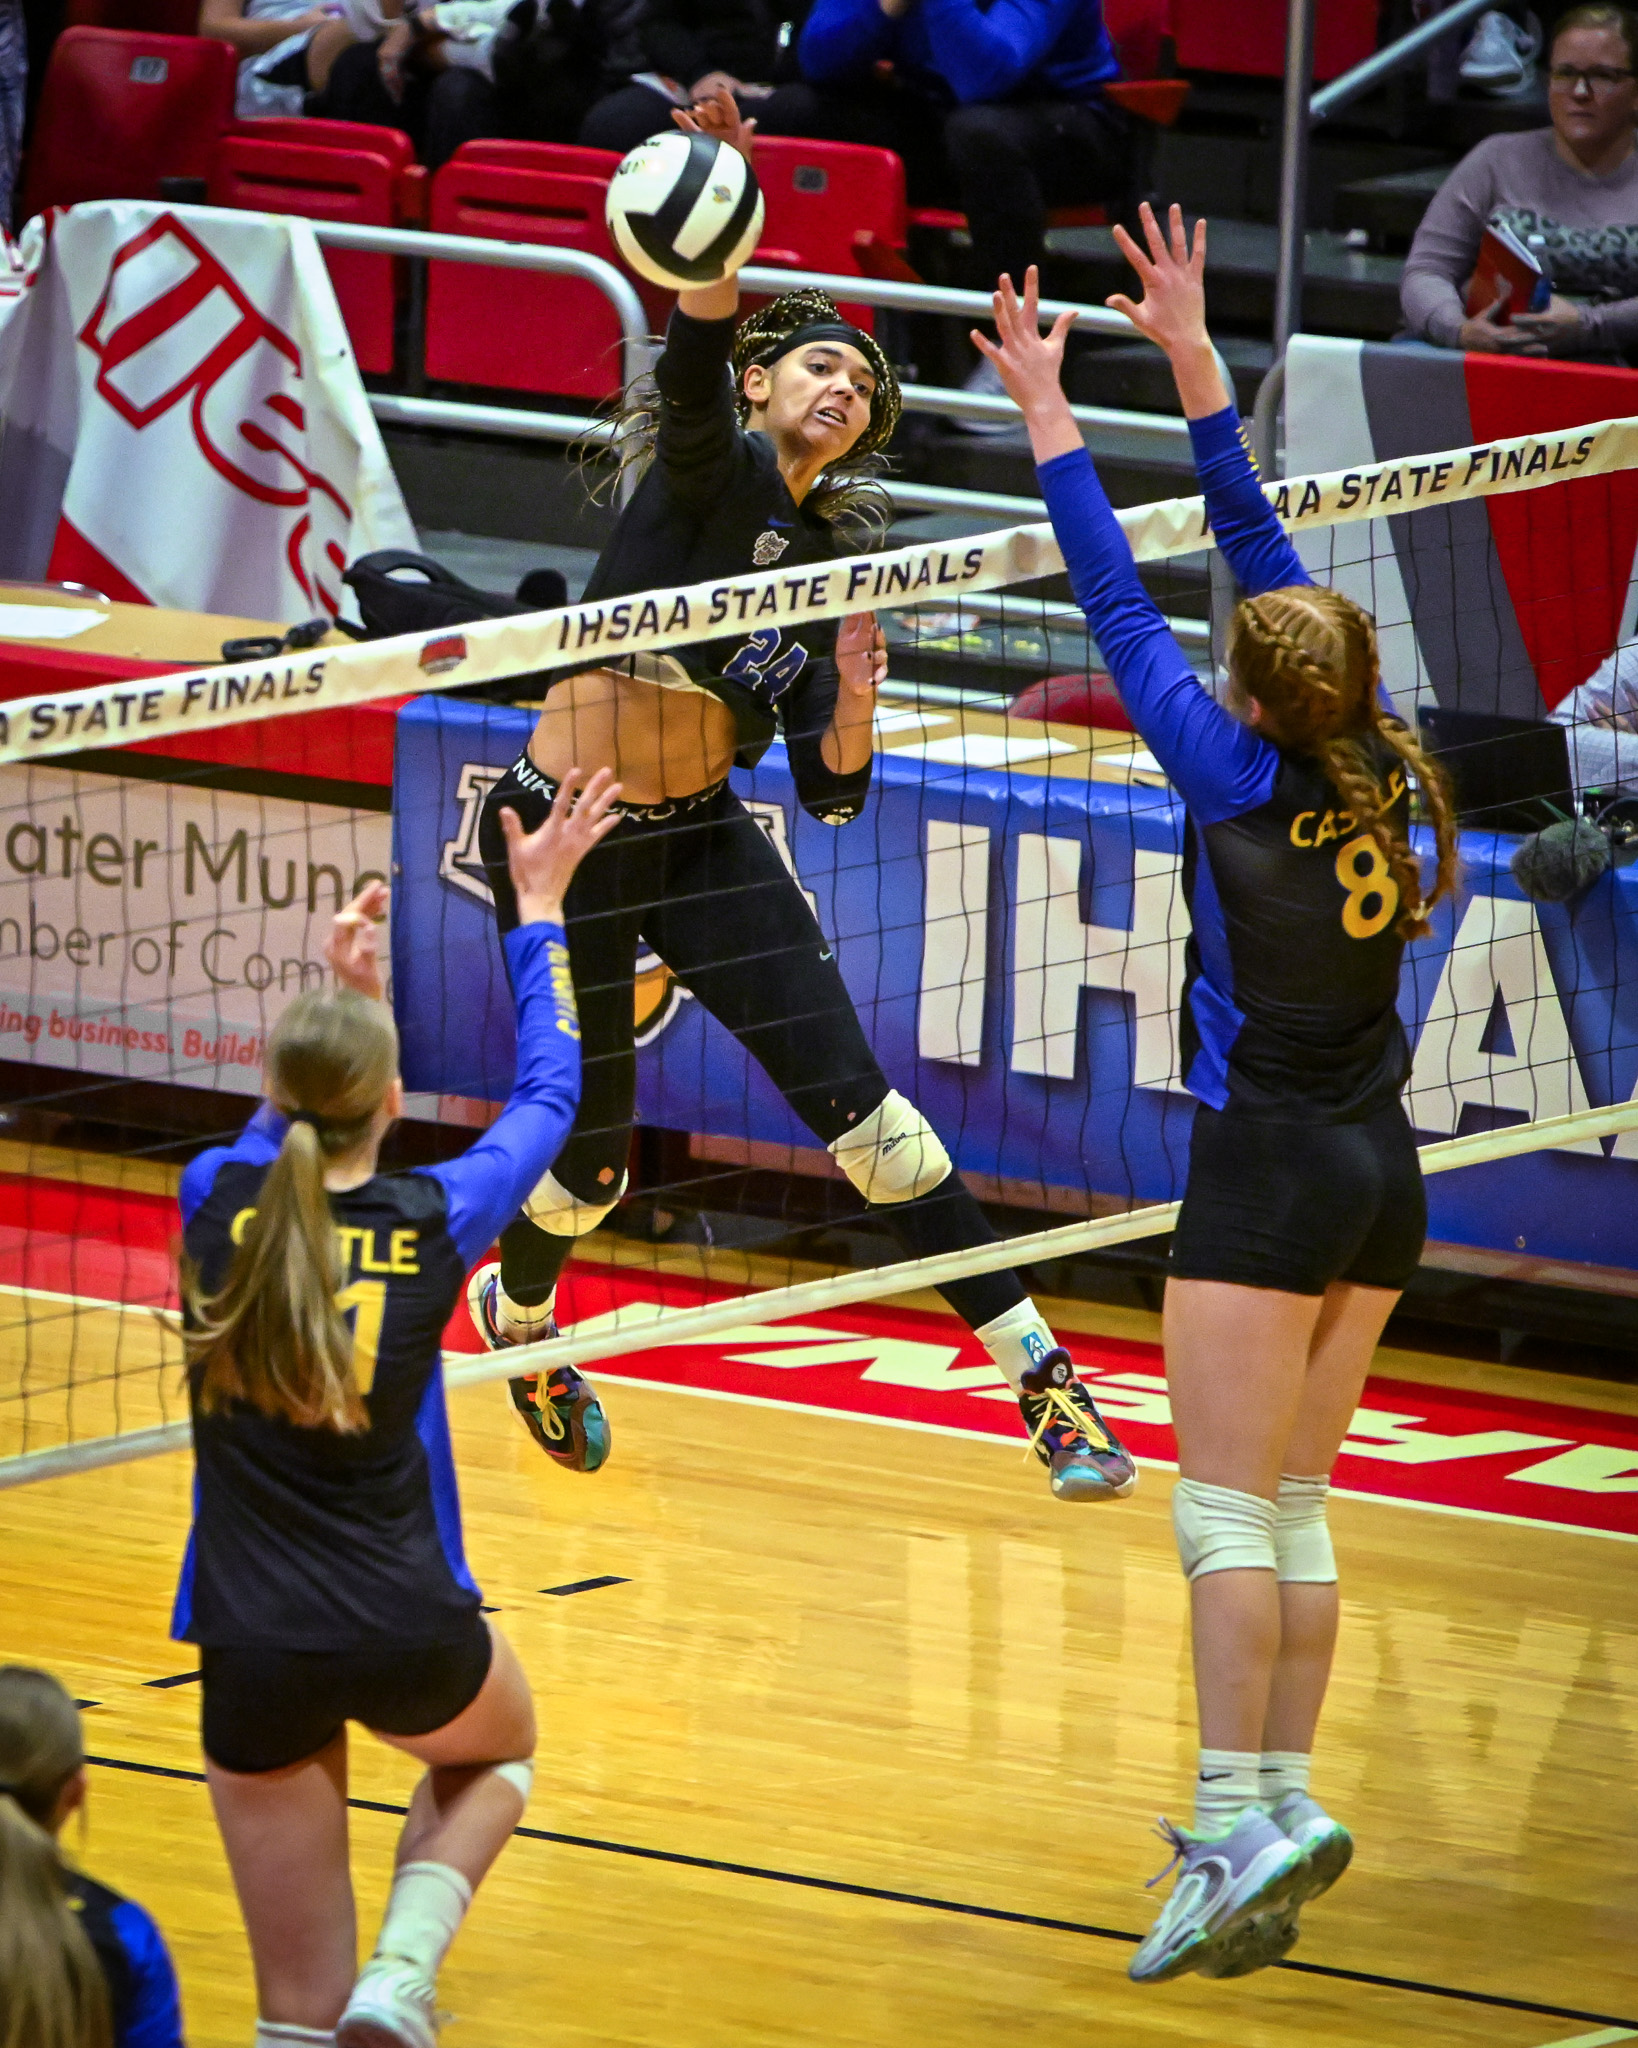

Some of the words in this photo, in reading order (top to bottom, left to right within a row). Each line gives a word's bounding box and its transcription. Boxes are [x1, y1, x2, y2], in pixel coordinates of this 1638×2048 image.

[1336, 462, 1454, 510] STATE
[1463, 436, 1595, 486] FINALS
[558, 595, 691, 650] IHSAA
[708, 574, 831, 625] STATE
[846, 548, 984, 602] FINALS
[29, 689, 164, 740] STATE
[180, 662, 326, 716] FINALS
[722, 626, 809, 704] 24
[512, 757, 557, 802] NIK
[1335, 834, 1399, 939] 8
[132, 921, 188, 978] of
[231, 1207, 420, 1274] CTLE
